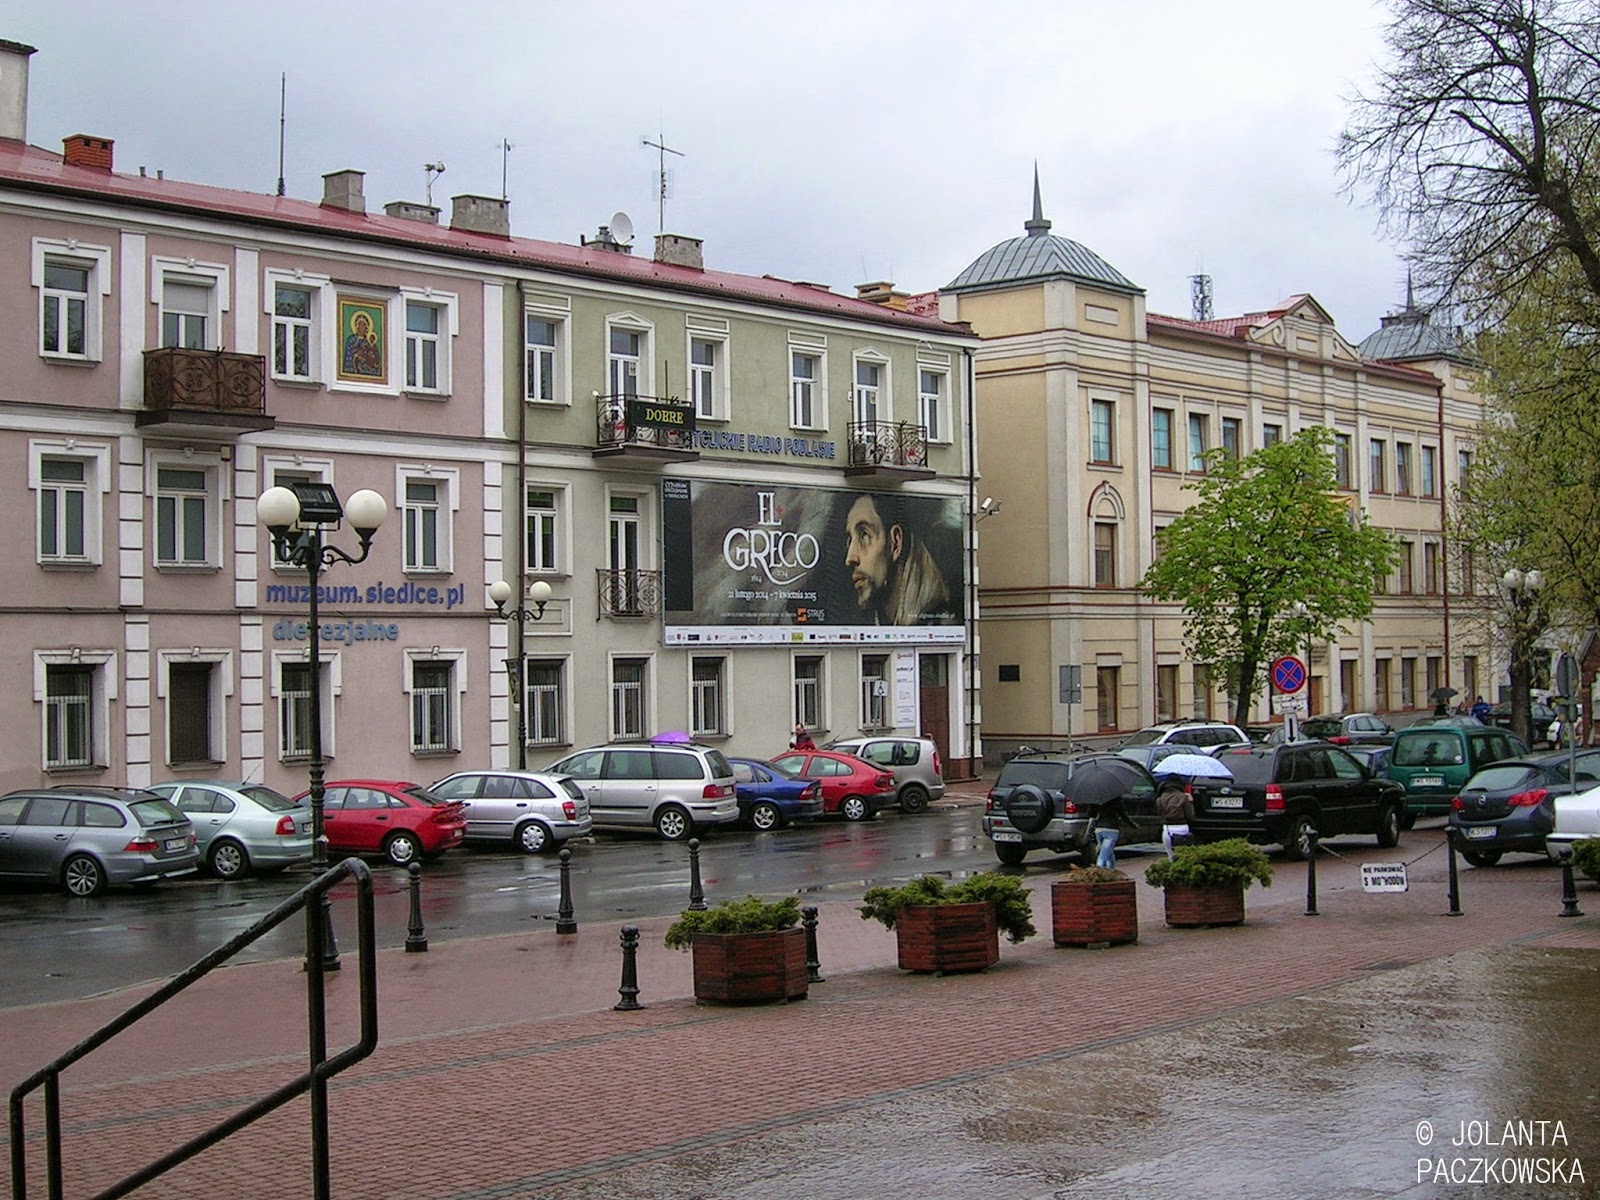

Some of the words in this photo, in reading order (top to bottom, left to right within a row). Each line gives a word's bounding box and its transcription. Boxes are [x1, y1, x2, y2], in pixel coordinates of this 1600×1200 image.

[645, 408, 684, 424] DOBRE
[747, 433, 783, 454] RADIO
[785, 437, 836, 460] PODLASIE
[757, 491, 782, 526] EL
[723, 527, 820, 585] GRECO
[735, 588, 755, 601] lutego
[755, 591, 769, 600] 2014
[779, 590, 804, 600] kwietnia
[272, 617, 399, 646] dieezjalne
[1010, 809, 1037, 817] TOYOTA
[1363, 874, 1405, 886] SMOHODÓW
